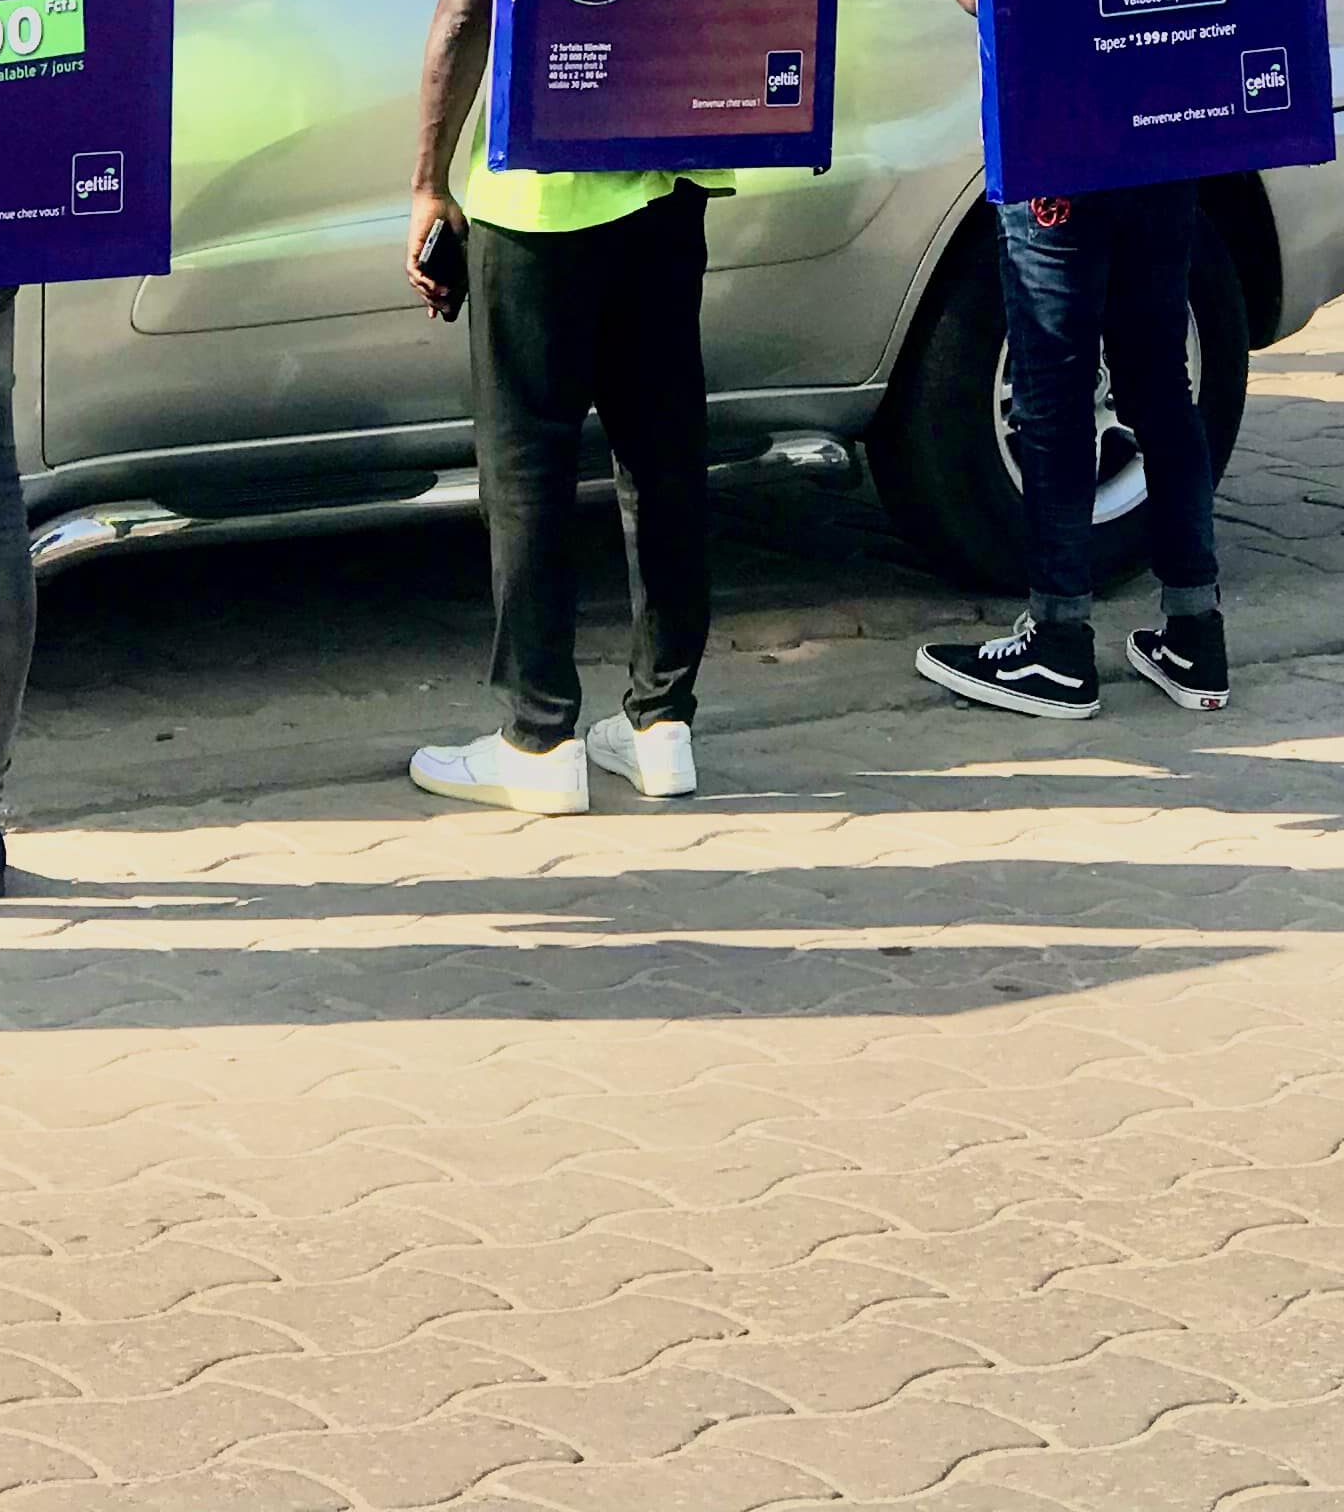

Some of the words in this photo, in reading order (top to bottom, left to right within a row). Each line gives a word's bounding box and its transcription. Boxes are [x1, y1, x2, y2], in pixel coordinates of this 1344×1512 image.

[1094, 36, 1126, 53] Tapez
[1171, 28, 1197, 45] pour
[1199, 23, 1237, 39] activer
[40, 63, 48, 77] 7
[51, 58, 85, 76] jours
[768, 71, 799, 86] celtiis
[1245, 71, 1286, 91] celtiis
[1132, 110, 1183, 127] Bienvenue
[1183, 108, 1206, 122] chez
[1207, 105, 1229, 118] vous
[76, 173, 119, 194] celtiis
[17, 207, 37, 220] chez
[39, 207, 60, 219] vous
